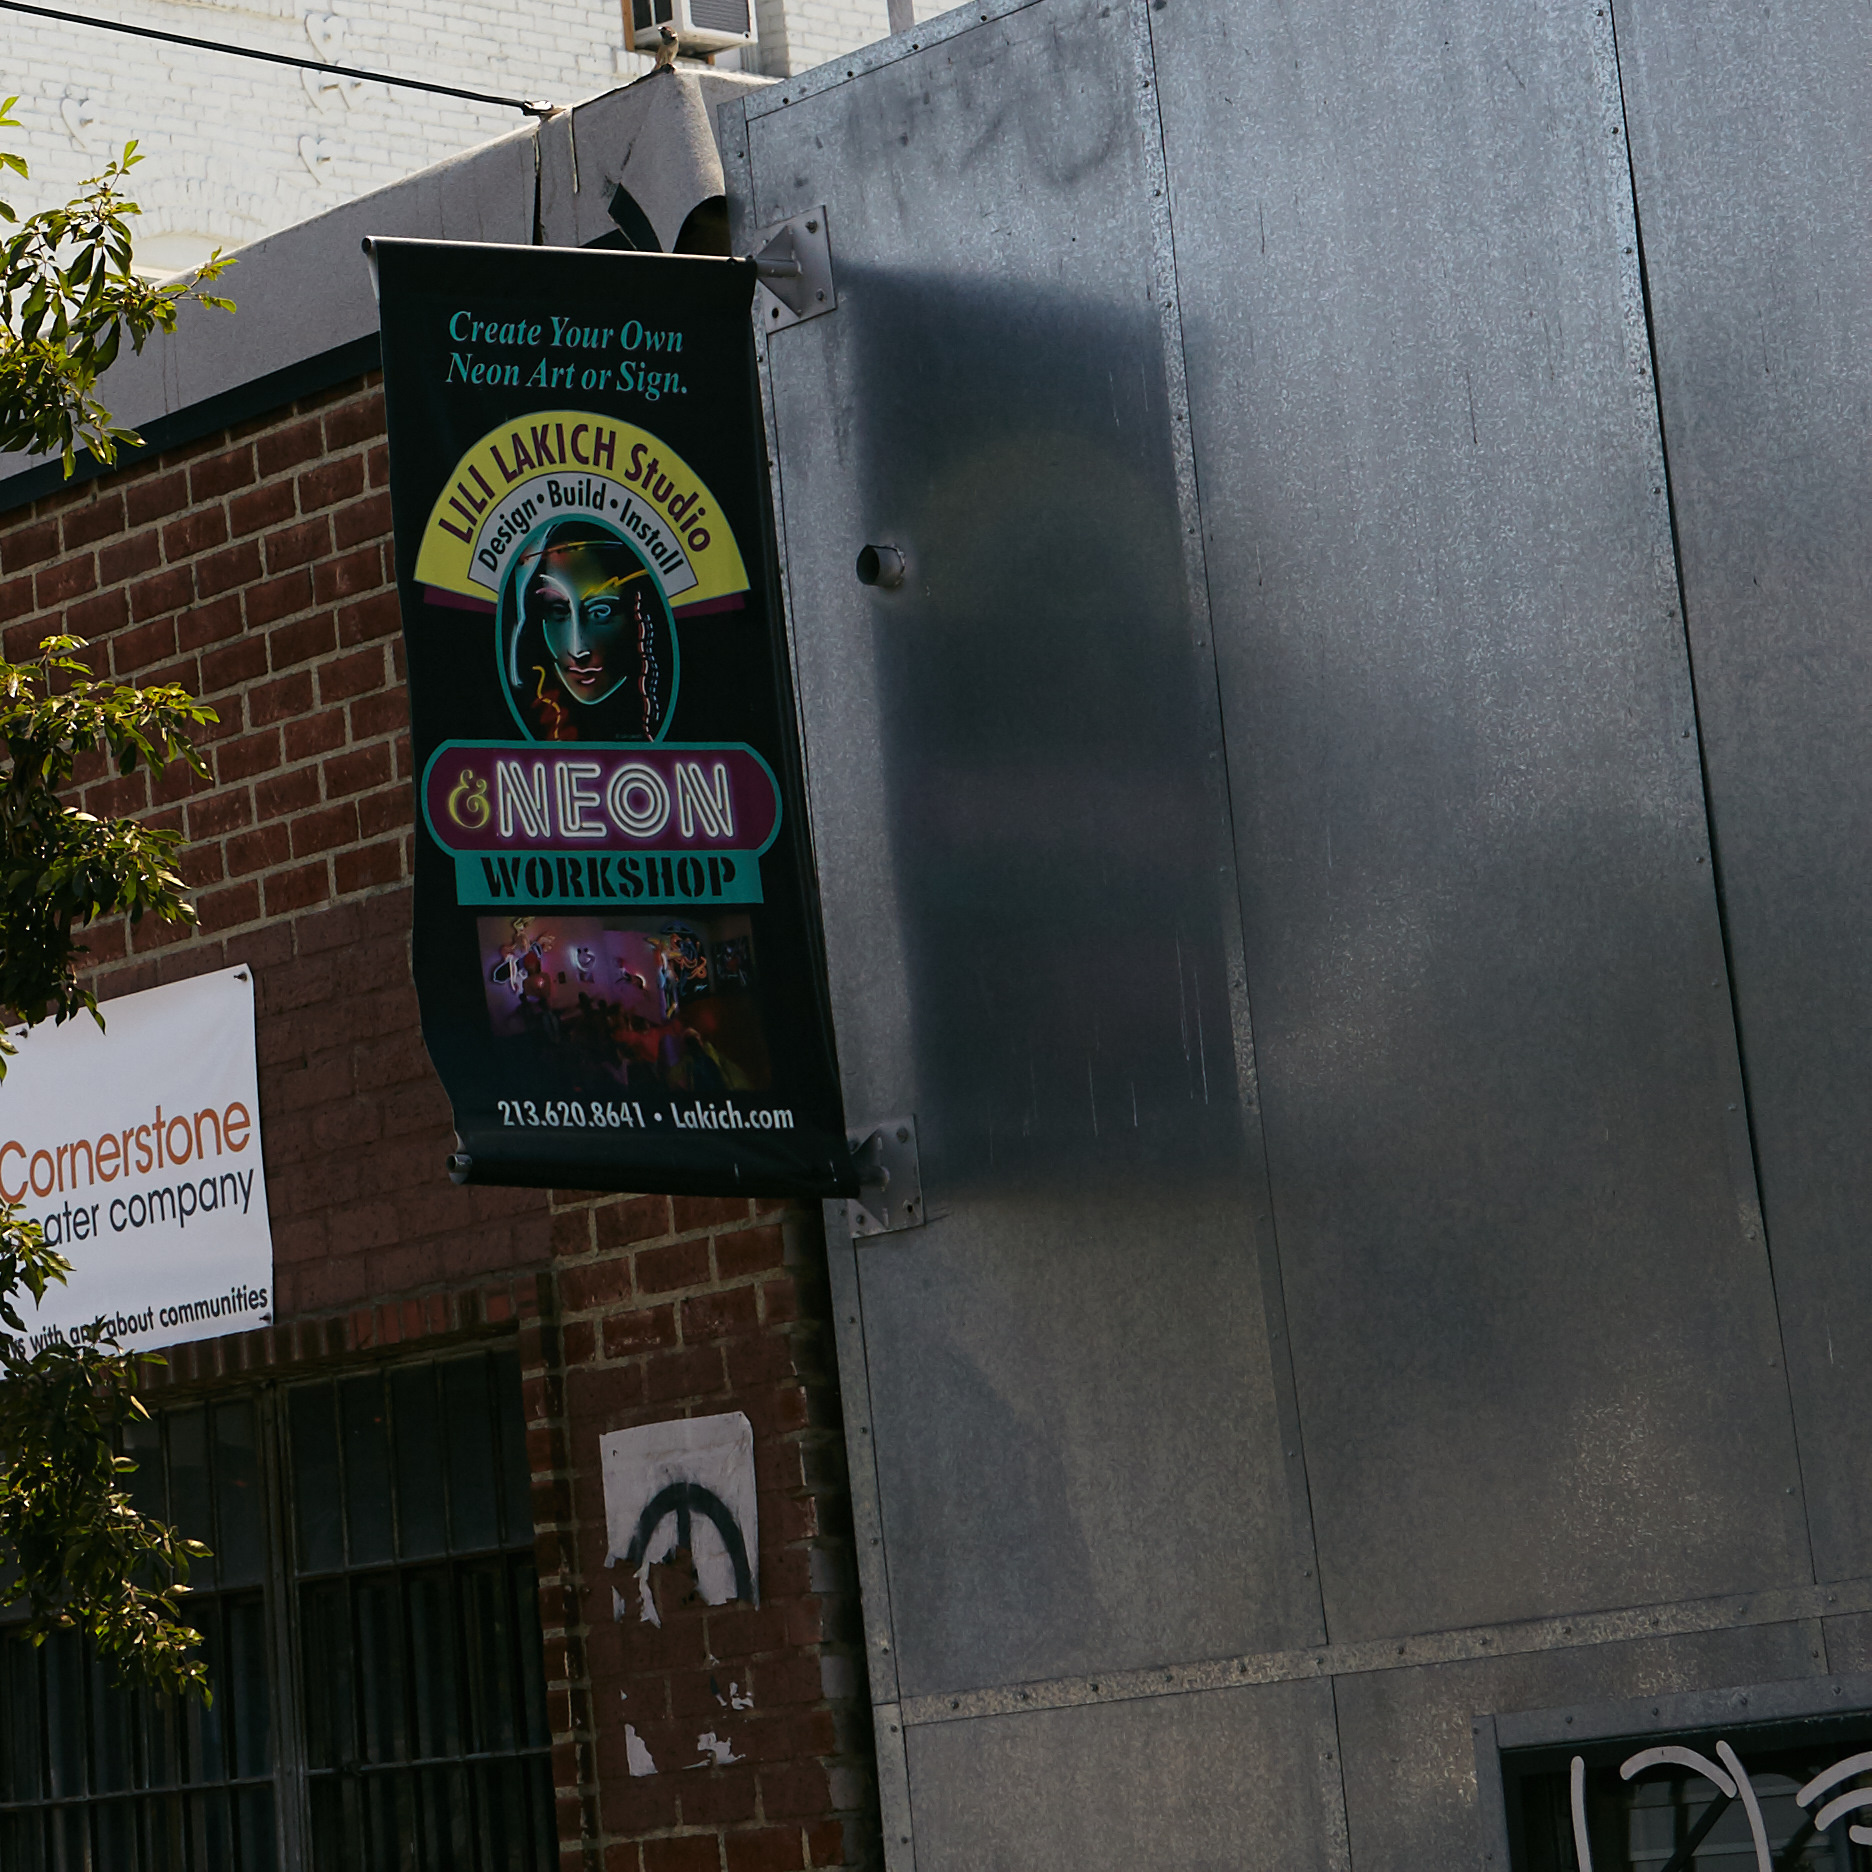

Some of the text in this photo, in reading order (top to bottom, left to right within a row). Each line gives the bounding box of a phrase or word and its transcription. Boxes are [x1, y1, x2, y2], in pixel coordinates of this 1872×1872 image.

[449, 310, 684, 352] Create Your Own
[445, 352, 688, 401] Neon Art or Sign.
[437, 422, 711, 554] LILI LAKICH Studio
[477, 478, 685, 575] Design Build Install
[447, 760, 735, 839] & NEON
[480, 855, 736, 899] WORKSHOP
[497, 1100, 795, 1130] 213.620.8641 Lakich.com
[109, 1168, 255, 1229] company
[107, 1307, 154, 1340] about
[159, 1285, 269, 1329] communities
